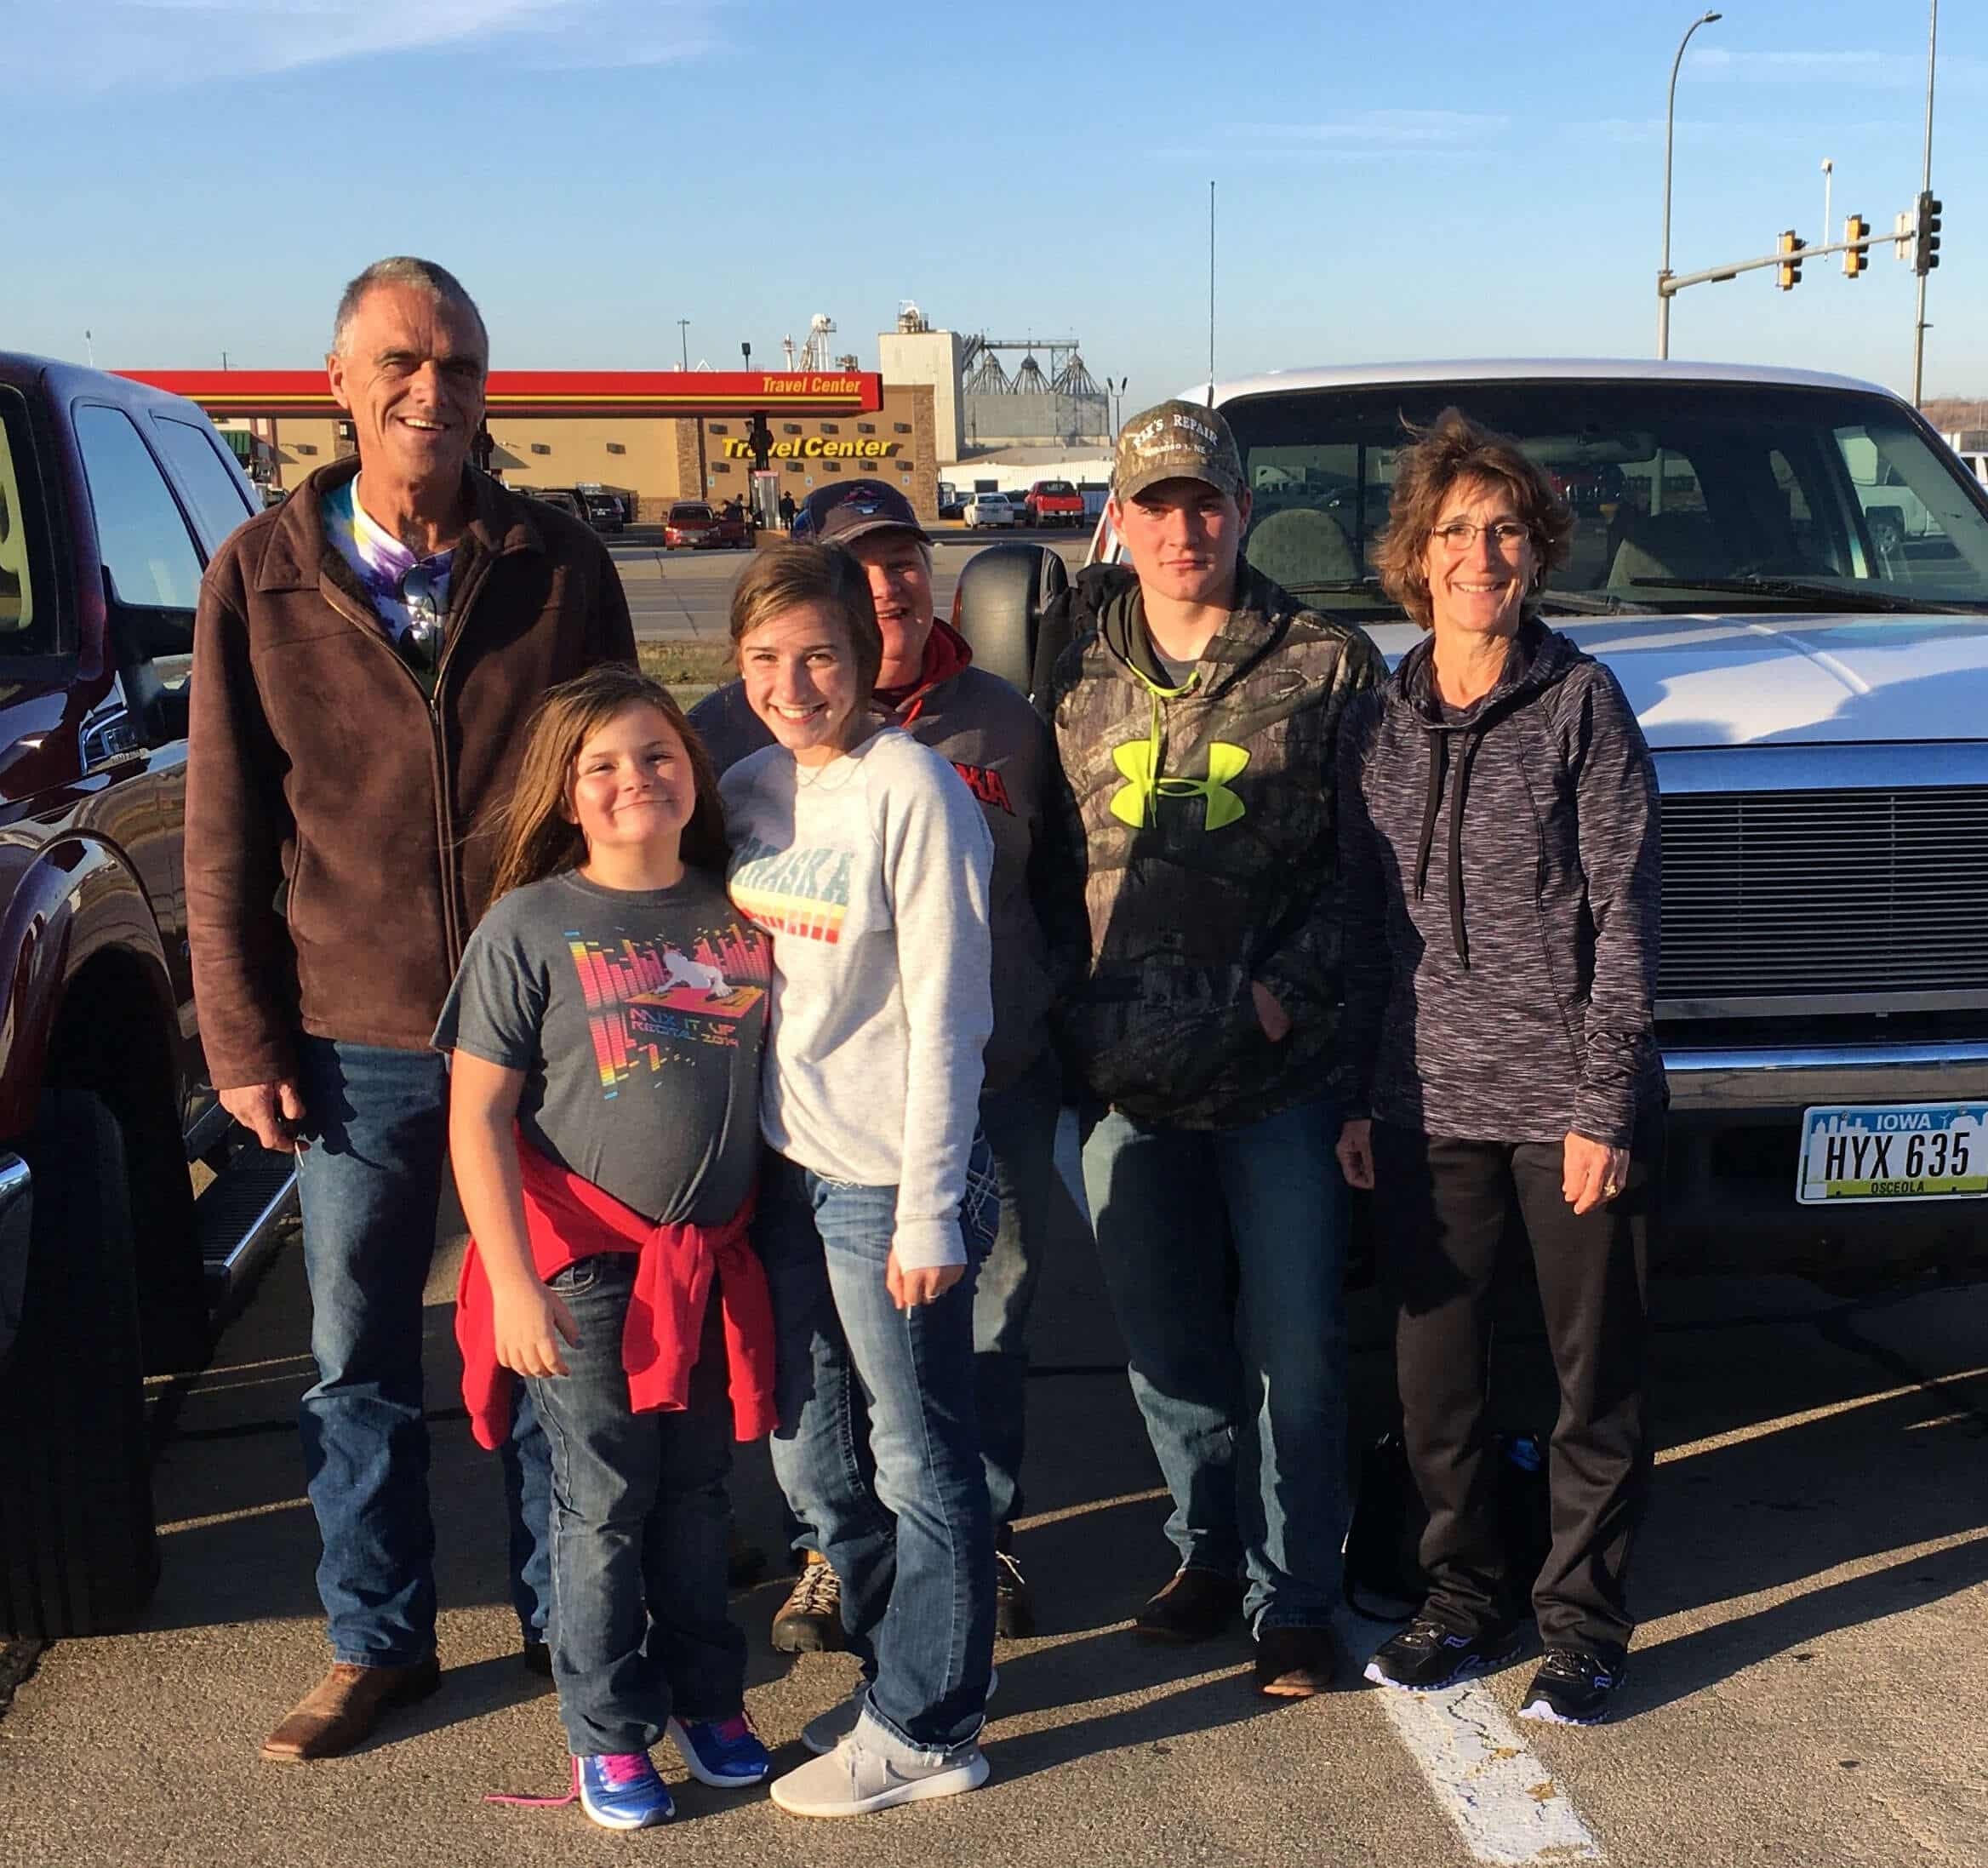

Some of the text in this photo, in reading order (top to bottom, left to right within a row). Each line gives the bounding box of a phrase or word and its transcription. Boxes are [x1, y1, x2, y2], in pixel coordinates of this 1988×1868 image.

[763, 377, 861, 393] Travel Center
[1173, 414, 1218, 446] REPAIR
[804, 437, 892, 457] Center
[1877, 1113, 1932, 1131] IOWA
[1825, 1132, 1970, 1180] HYX 635
[1871, 1180, 1925, 1193] OSCEOLA
